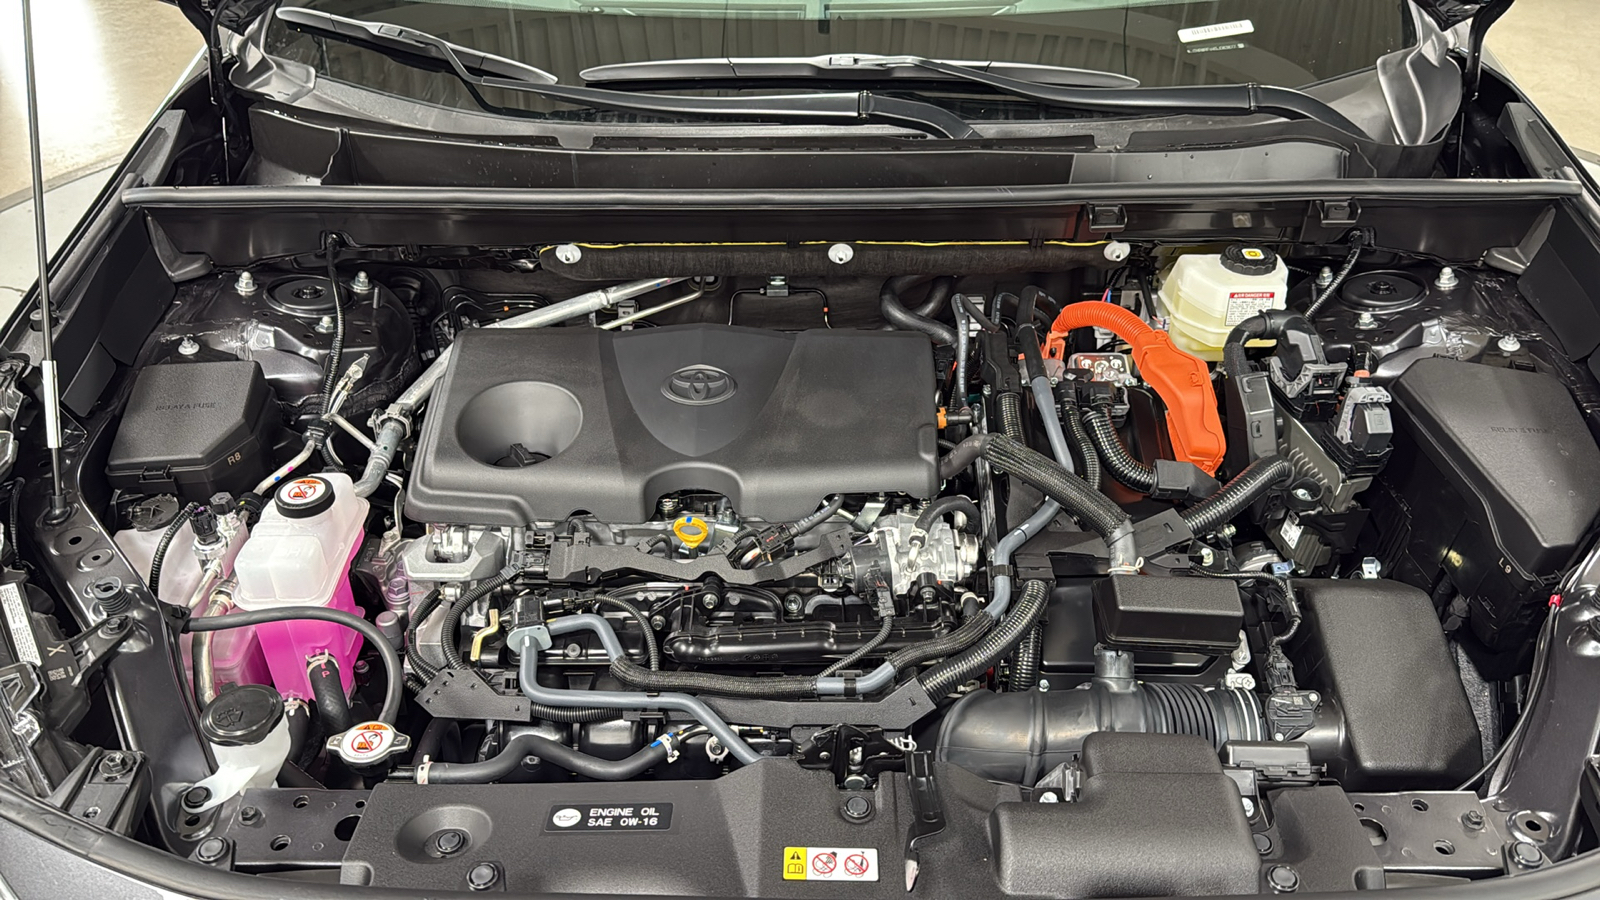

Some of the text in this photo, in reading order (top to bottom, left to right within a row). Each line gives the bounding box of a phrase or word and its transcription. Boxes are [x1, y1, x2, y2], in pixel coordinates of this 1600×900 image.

[227, 452, 242, 466] R8
[589, 807, 660, 817] ENGINE OIL
[587, 817, 658, 827] SAE 0W-16
